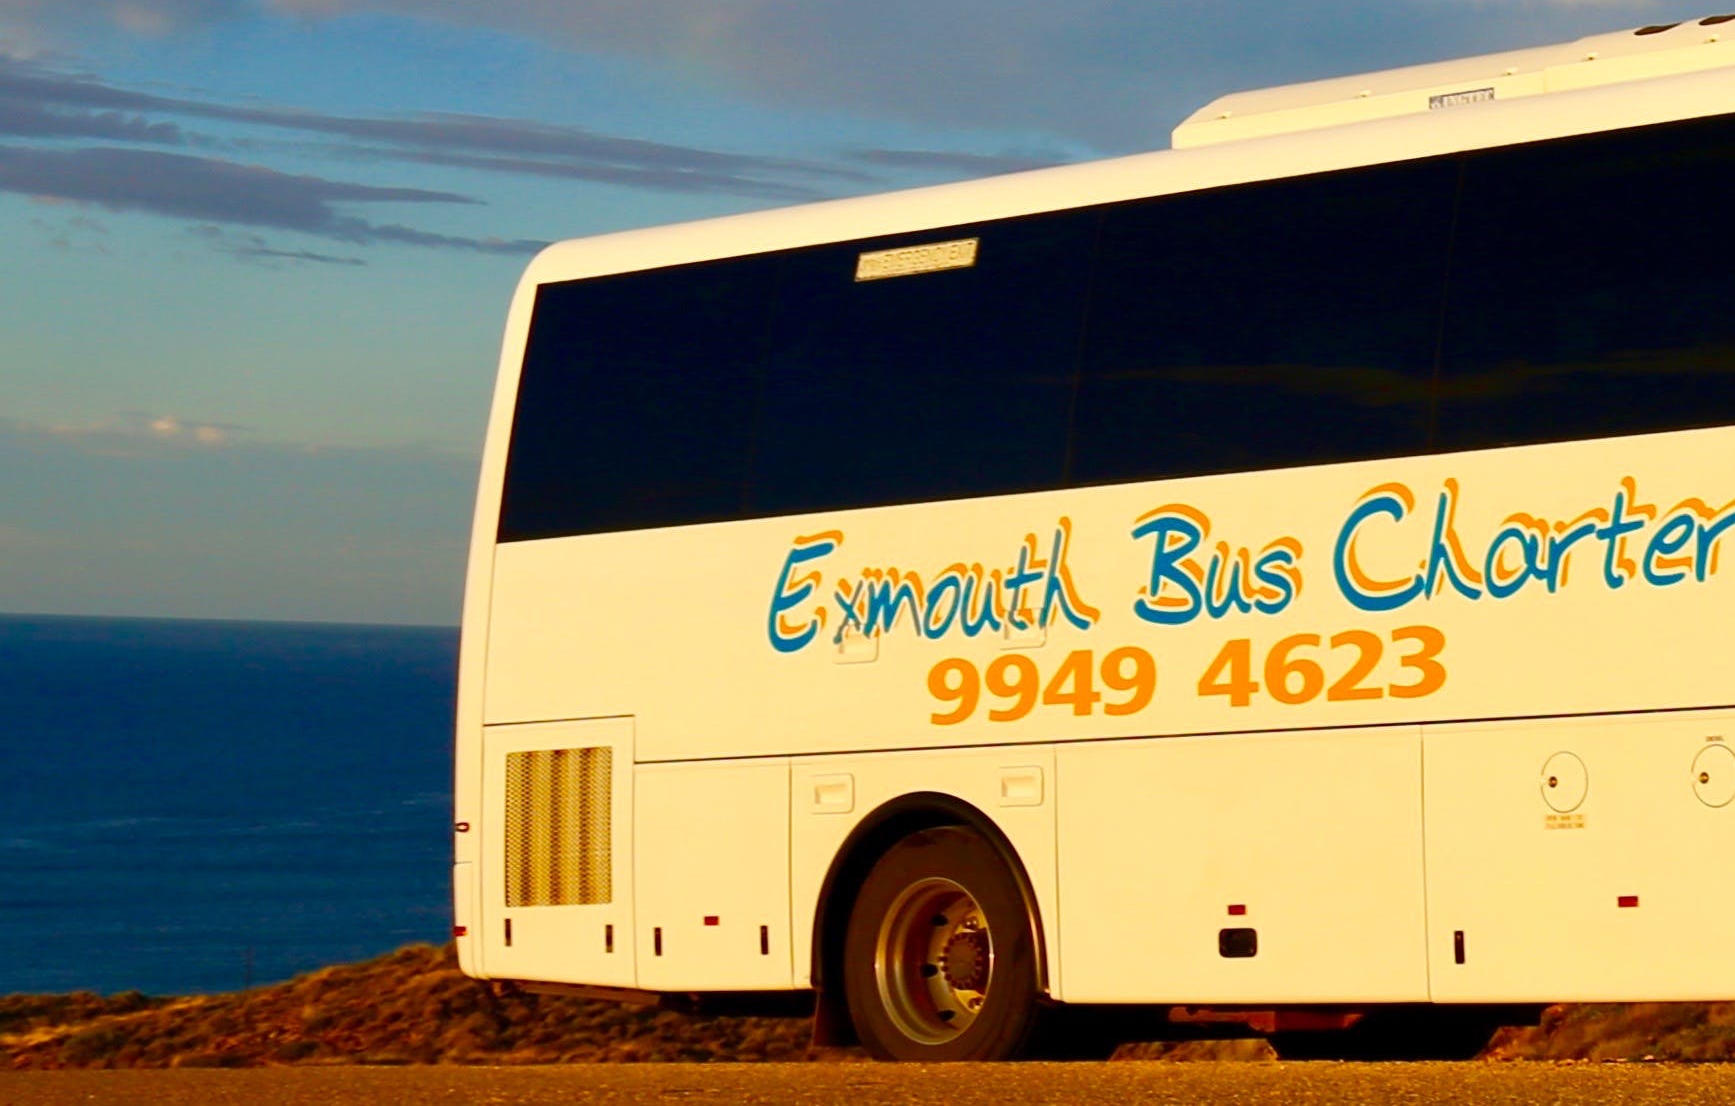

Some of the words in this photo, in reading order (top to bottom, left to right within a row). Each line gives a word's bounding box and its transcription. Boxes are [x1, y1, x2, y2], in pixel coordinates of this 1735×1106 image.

[767, 515, 1100, 653] Exmouth
[1130, 503, 1303, 625] Bus
[927, 645, 1156, 726] 9949
[1197, 625, 1448, 708] 4623
